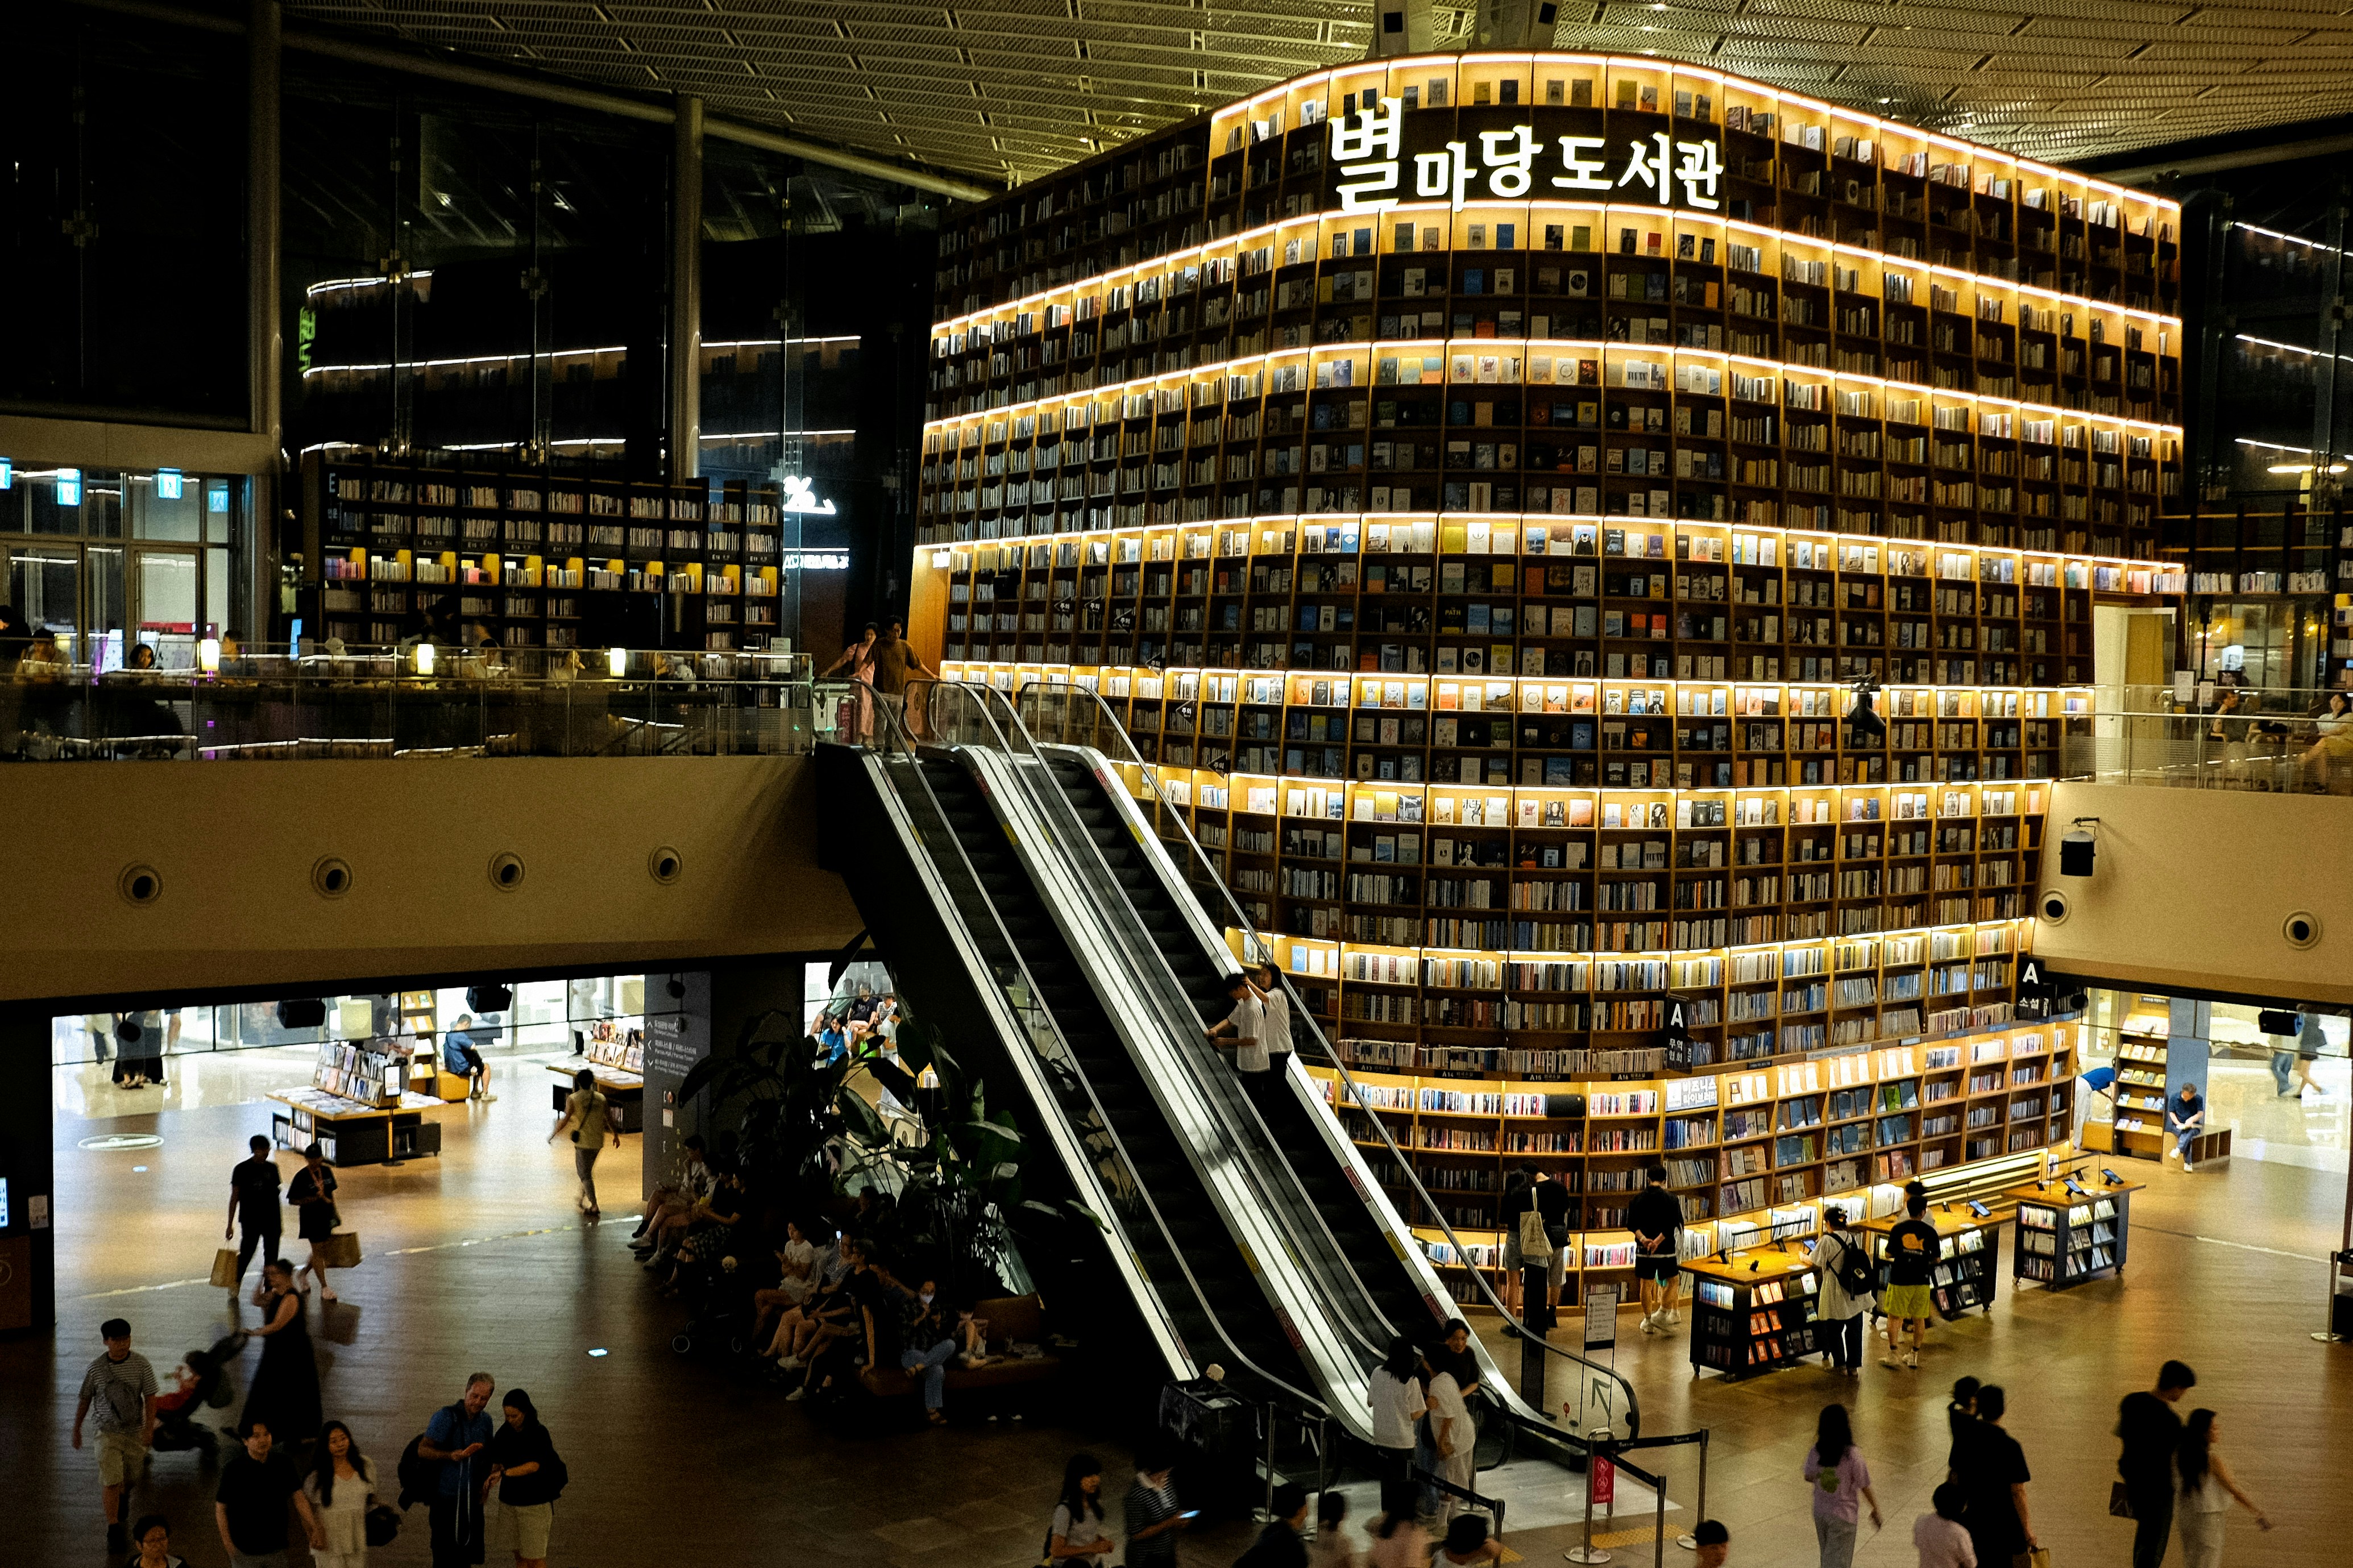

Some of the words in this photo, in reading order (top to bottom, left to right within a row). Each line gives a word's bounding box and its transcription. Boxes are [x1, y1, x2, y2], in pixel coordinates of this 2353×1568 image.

[1328, 96, 1543, 213] 별마당
[1551, 131, 1724, 210] 도서관
[329, 472, 336, 493] E
[2022, 962, 2039, 984] A
[2018, 997, 2039, 1010] 소설
[1670, 1003, 1684, 1028] A
[1682, 1078, 1717, 1094] 비즈니스
[1683, 1090, 1717, 1106] 라이브러리
